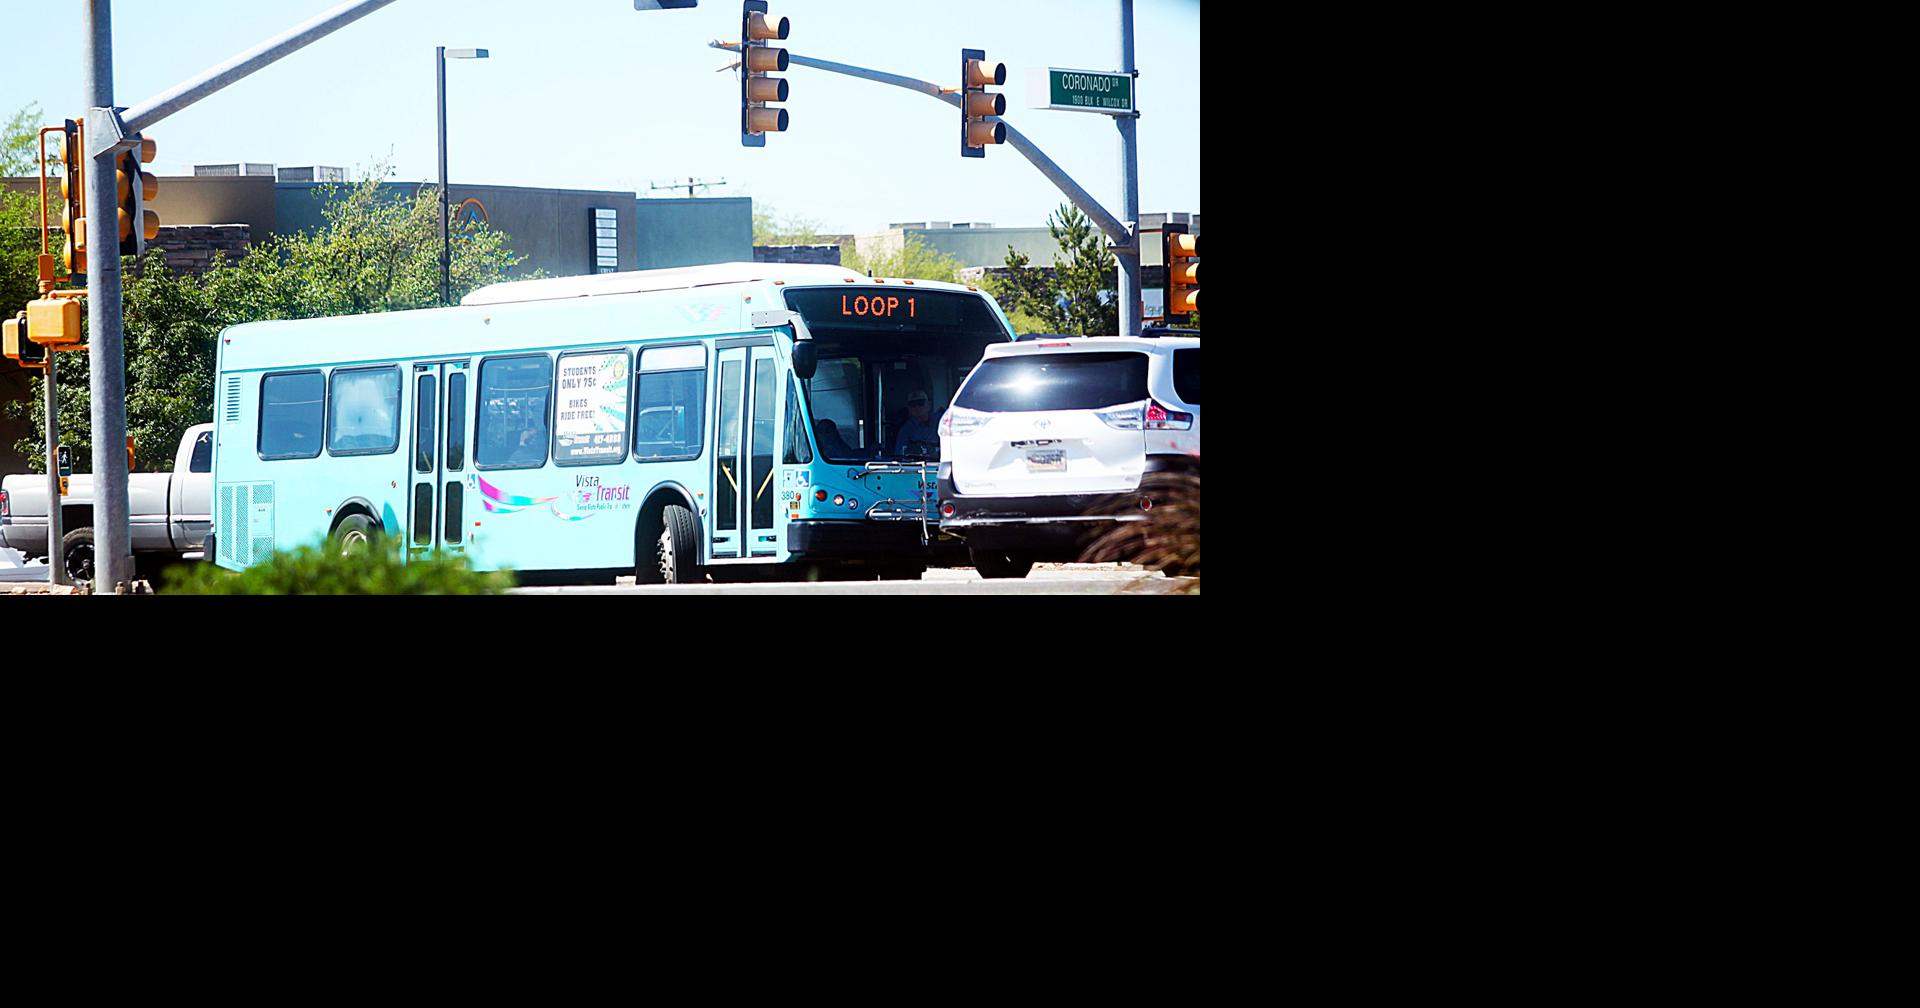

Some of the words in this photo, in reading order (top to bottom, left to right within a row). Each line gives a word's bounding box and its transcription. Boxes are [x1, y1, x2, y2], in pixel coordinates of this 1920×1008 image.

[1062, 74, 1111, 92] CORONADO
[1112, 77, 1119, 87] DR
[1085, 96, 1093, 106] BLK
[1096, 97, 1100, 106] E
[1103, 97, 1120, 107] WILCOX
[1121, 98, 1128, 108] DR
[842, 294, 899, 317] LOOP
[908, 296, 915, 318] 1
[563, 366, 597, 377] STUDENTS
[562, 378, 581, 389] ONLY
[569, 398, 588, 408] BIKES
[561, 411, 575, 421] RIDE
[576, 474, 599, 487] Vista
[596, 483, 630, 501] Transit
[781, 490, 795, 501] 380
